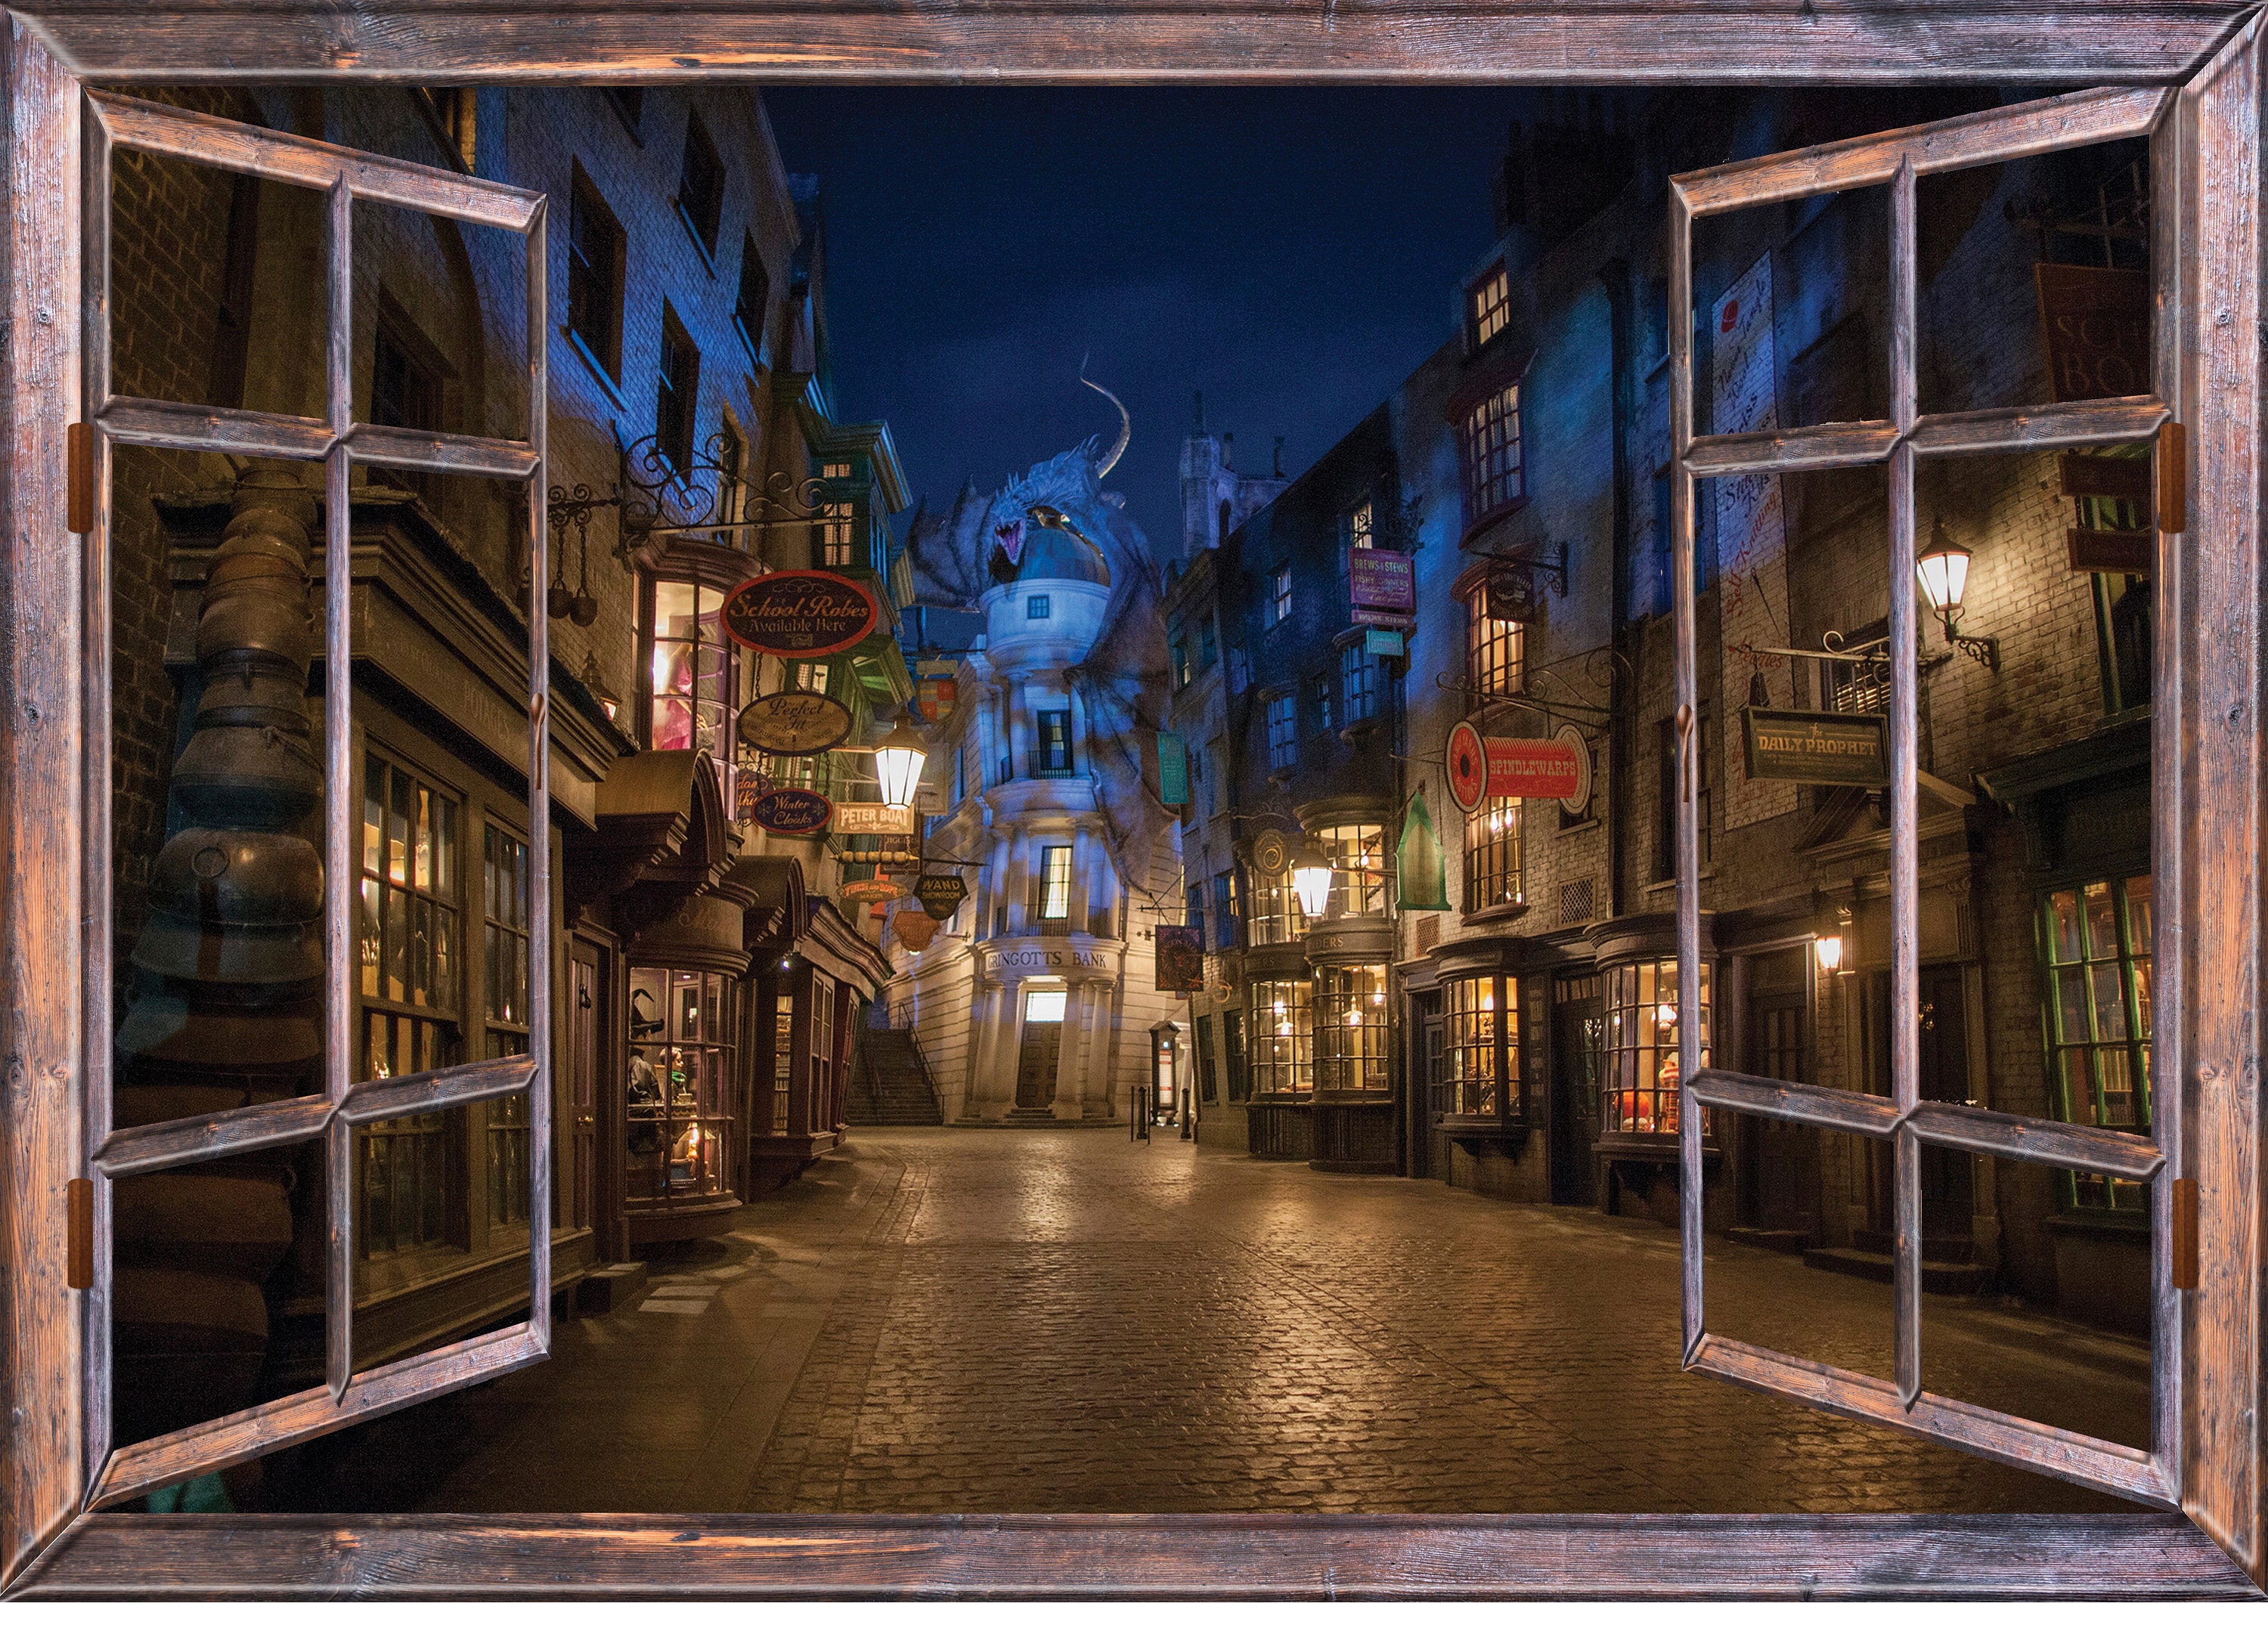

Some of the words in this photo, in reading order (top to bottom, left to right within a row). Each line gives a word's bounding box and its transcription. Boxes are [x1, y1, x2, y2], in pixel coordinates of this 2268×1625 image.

[1354, 559, 1379, 572] BREWS
[1384, 561, 1408, 574] STEWS
[730, 593, 806, 618] School
[804, 595, 869, 618] Robes
[749, 618, 810, 633] Available
[815, 618, 847, 632] Here
[769, 697, 825, 717] Perfect
[1758, 735, 1804, 752] DAILY
[1805, 738, 1877, 756] PROPHET
[1489, 760, 1576, 777] SPINDLEWARPS
[773, 795, 810, 810] Winter
[773, 811, 813, 825] Cloaks
[841, 808, 876, 827] PETER
[880, 809, 910, 826] BOAT
[922, 879, 961, 890] WAND
[922, 890, 961, 899] SHOWROOM
[988, 950, 1062, 969] GRINGOTTS
[1072, 951, 1106, 968] BANK
